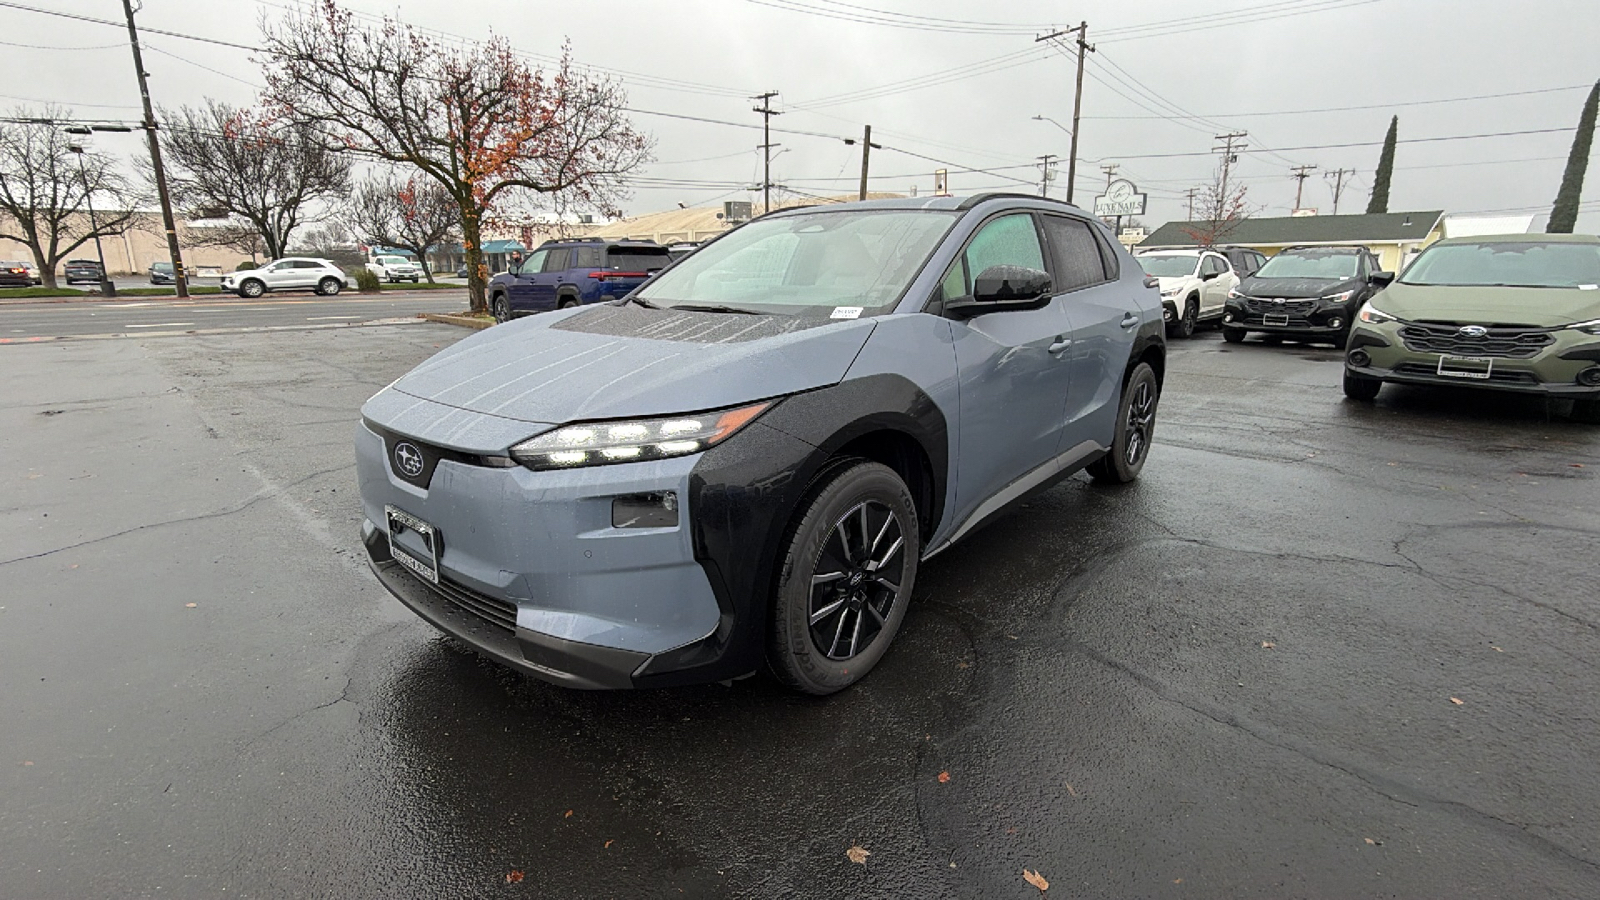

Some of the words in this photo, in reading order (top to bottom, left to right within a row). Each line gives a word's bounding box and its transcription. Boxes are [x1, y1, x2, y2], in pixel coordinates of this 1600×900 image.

[1096, 203, 1116, 212] LUXE
[1117, 202, 1143, 211] NAILS
[899, 489, 918, 529] TOYO
